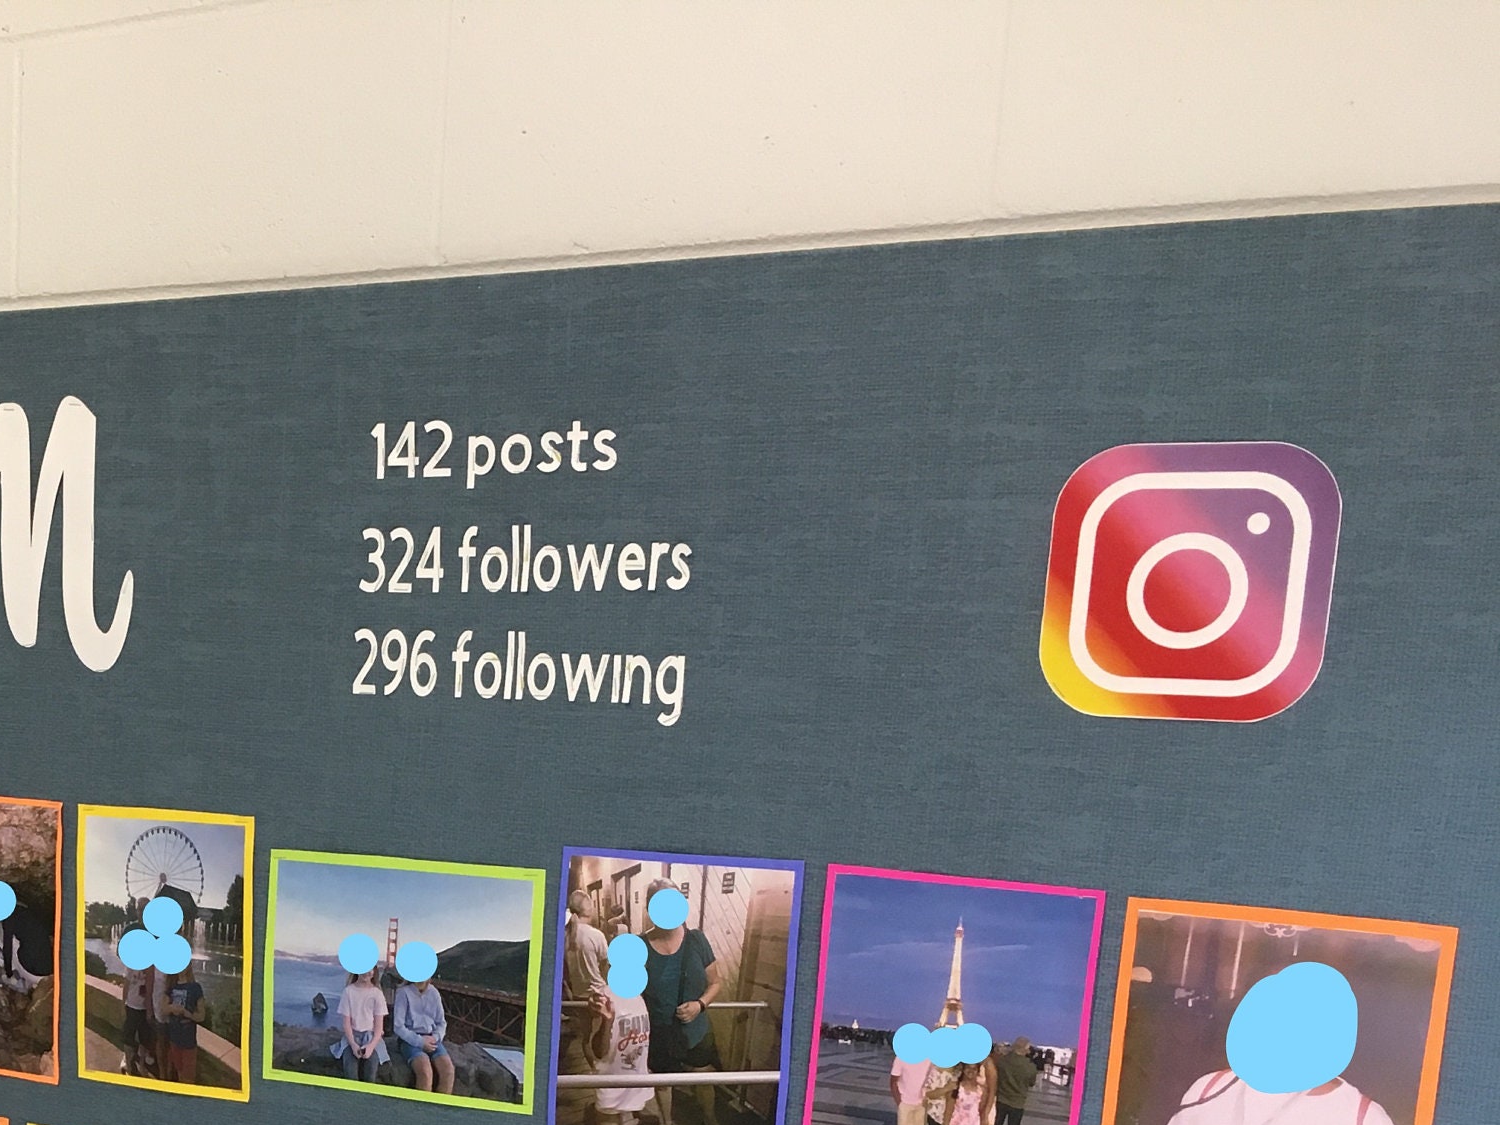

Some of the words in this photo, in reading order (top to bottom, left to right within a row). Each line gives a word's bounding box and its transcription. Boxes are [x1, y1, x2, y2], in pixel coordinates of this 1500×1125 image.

[370, 420, 453, 479] 142
[466, 420, 618, 489] posts
[358, 526, 444, 594] 324
[458, 524, 693, 593] followers
[352, 628, 438, 697] 296
[451, 629, 686, 727] following
